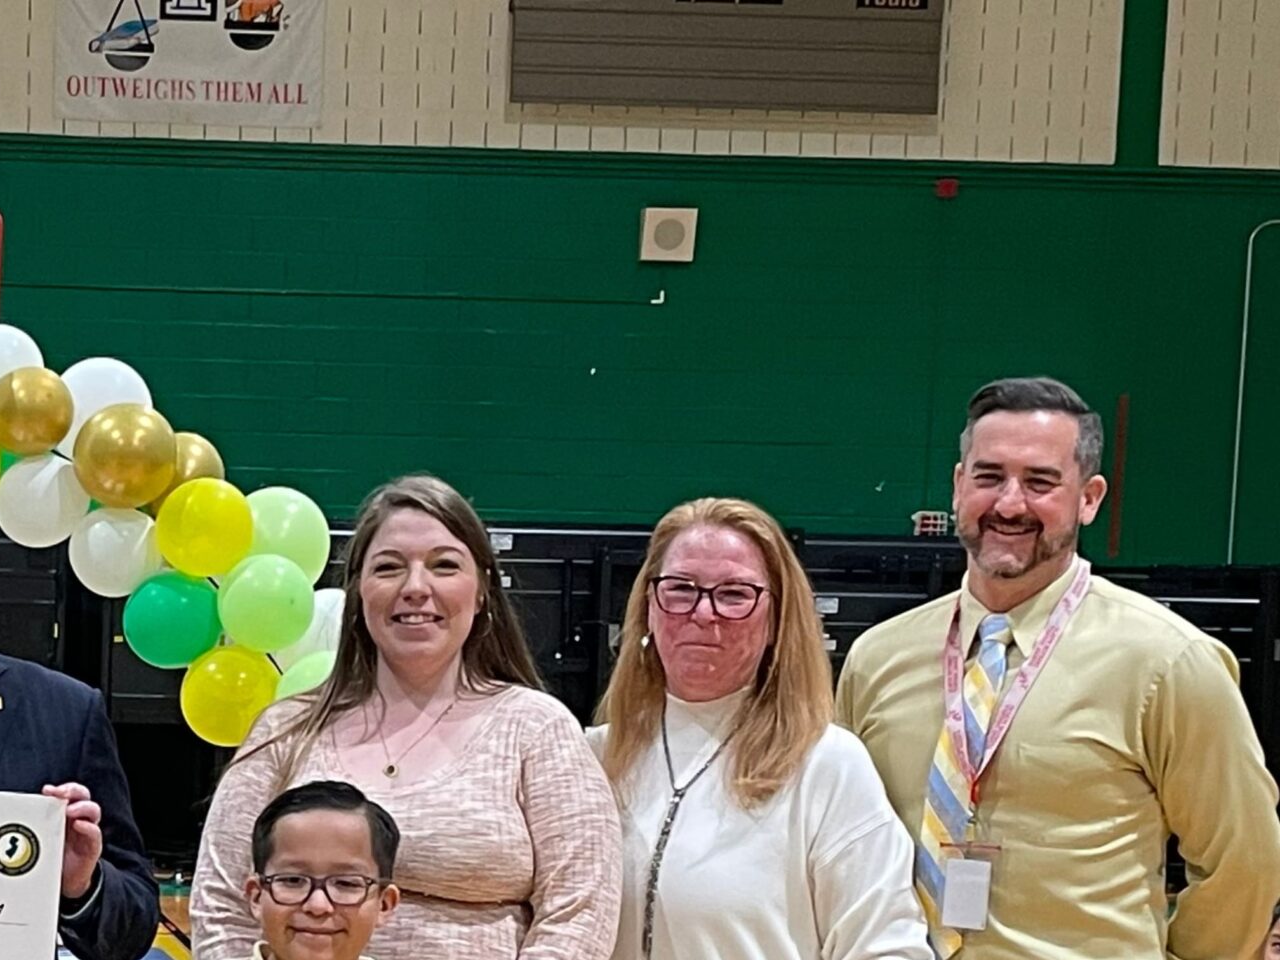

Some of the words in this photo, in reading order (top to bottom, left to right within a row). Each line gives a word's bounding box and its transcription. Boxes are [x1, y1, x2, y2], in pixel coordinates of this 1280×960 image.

[66, 75, 196, 100] OUTWEIGHS
[201, 81, 262, 103] THEM
[269, 83, 308, 104] ALL
